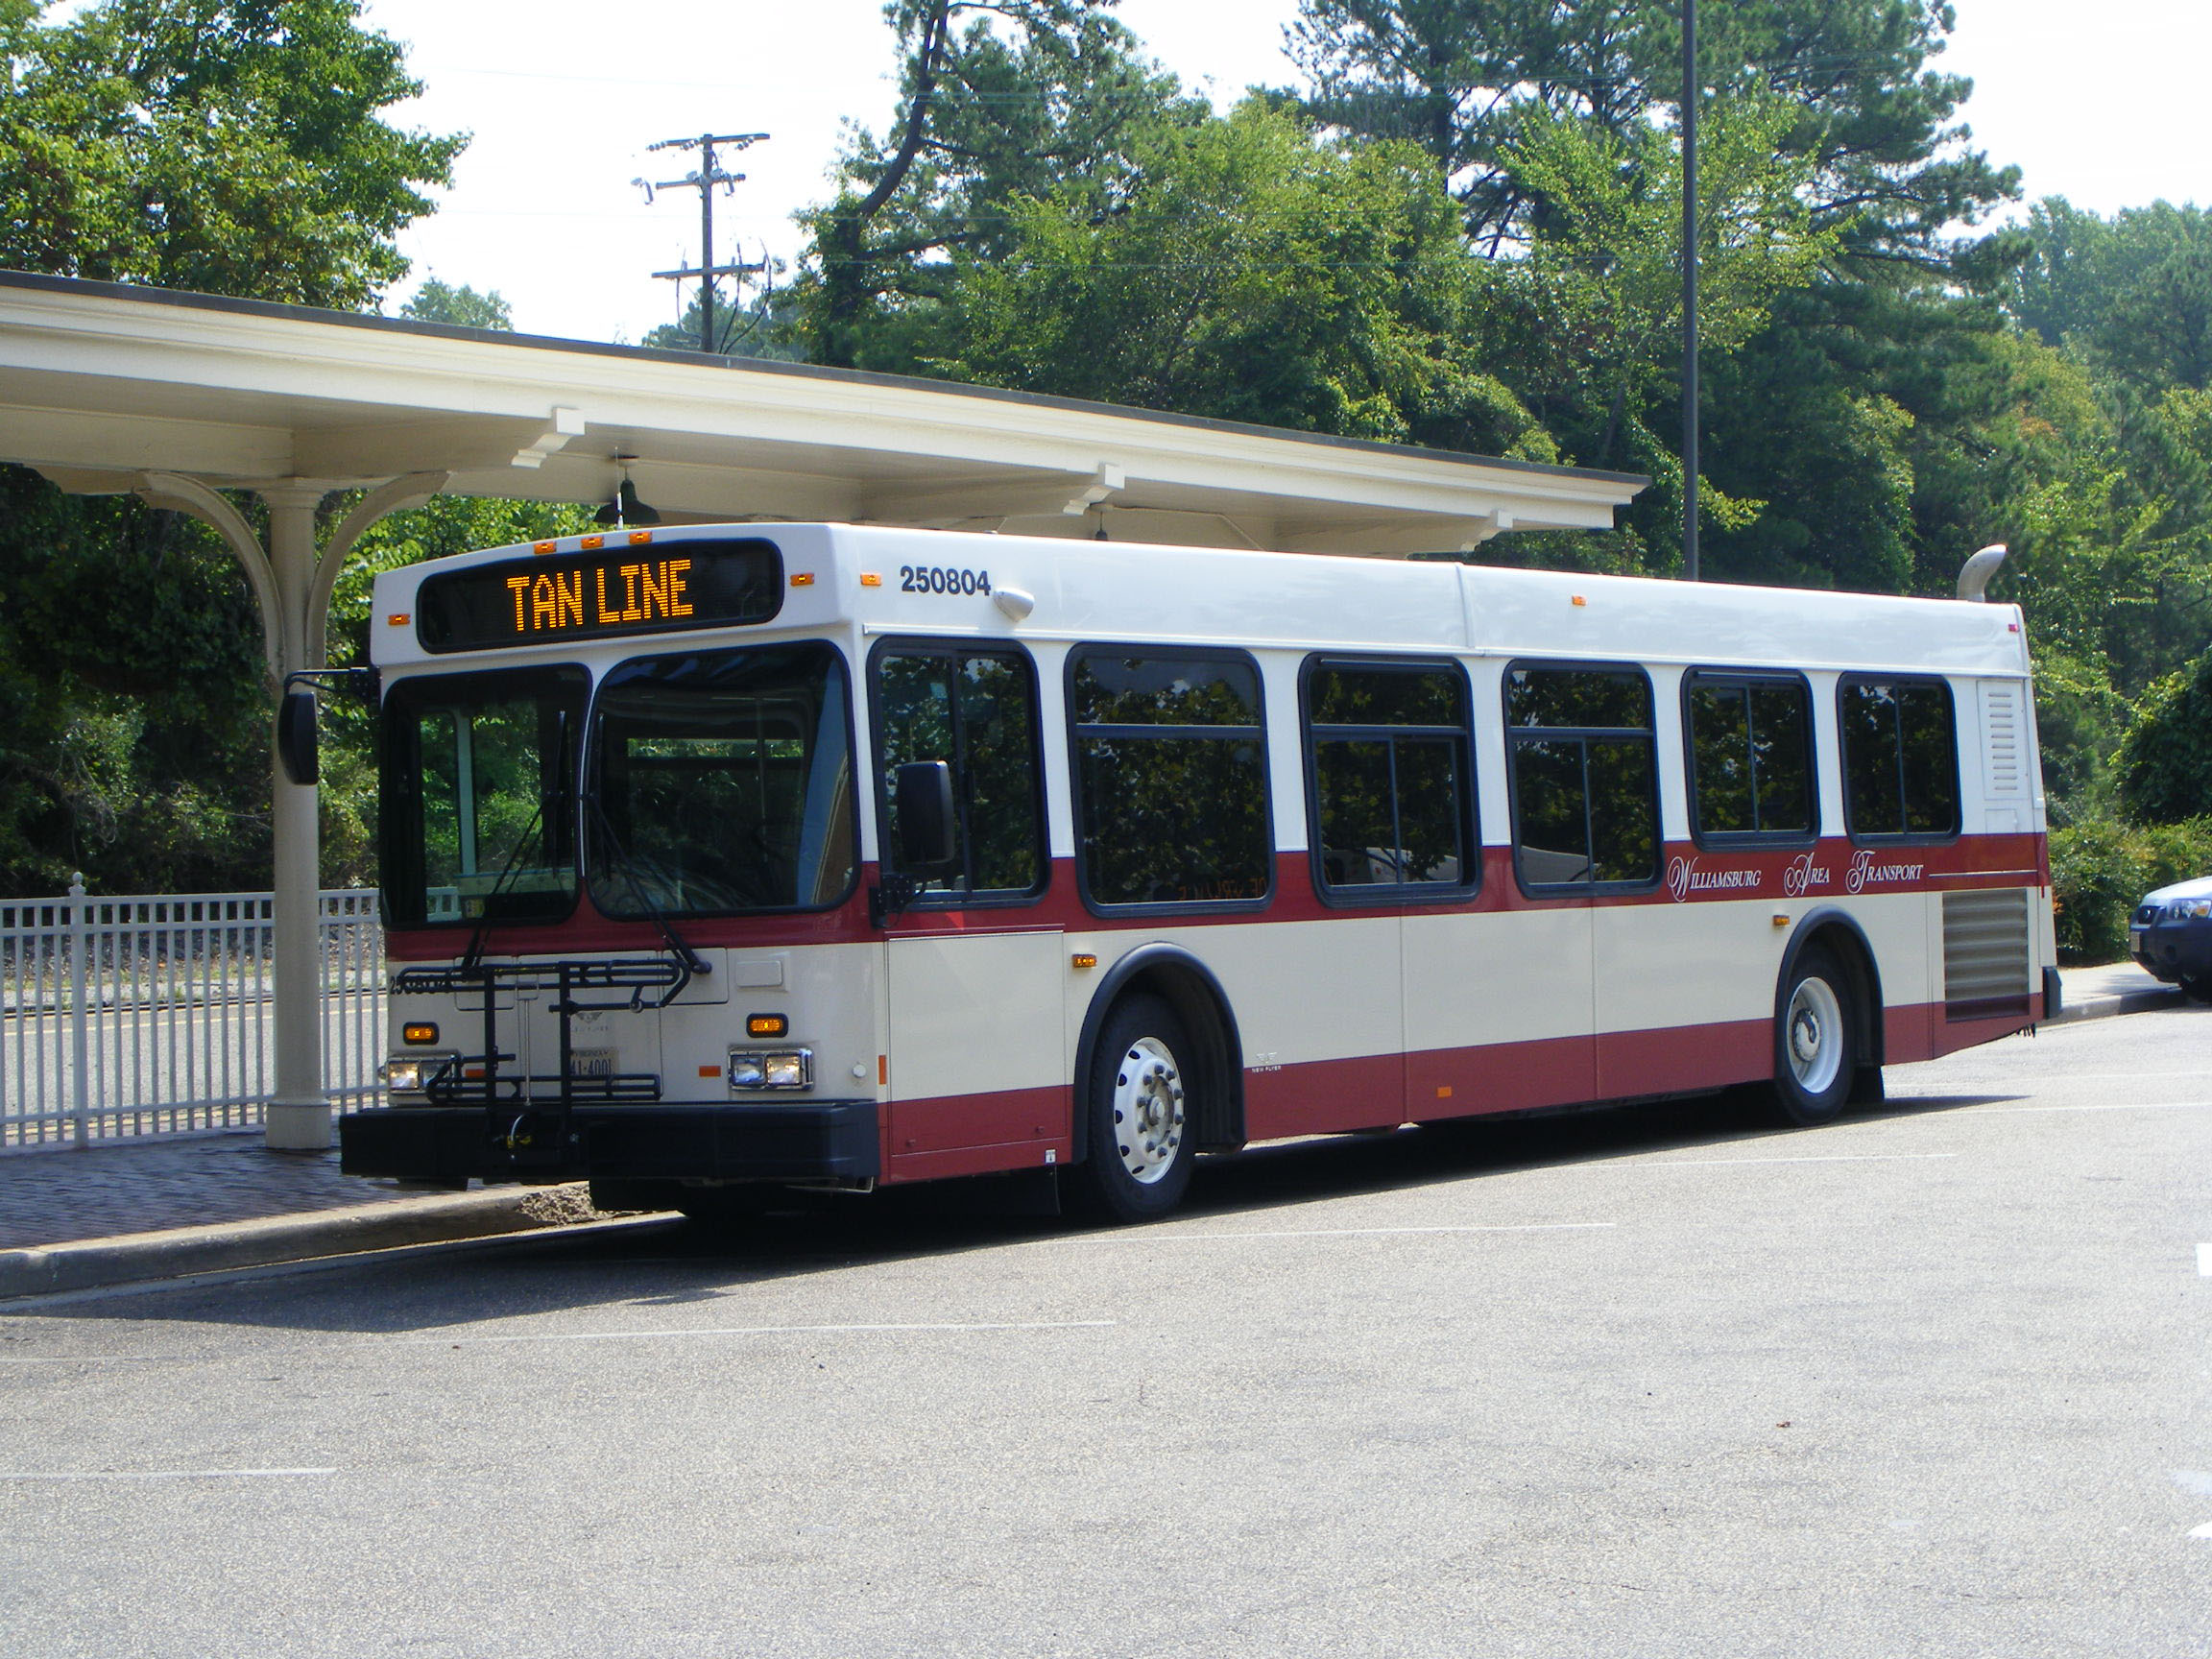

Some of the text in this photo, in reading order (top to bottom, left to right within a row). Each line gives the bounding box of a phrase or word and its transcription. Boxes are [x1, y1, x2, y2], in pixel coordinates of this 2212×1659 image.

[507, 559, 693, 631] TAN LINE
[900, 565, 991, 596] 250804
[1667, 850, 1924, 902] WILLIAMSBURG AREA TRANSPORT
